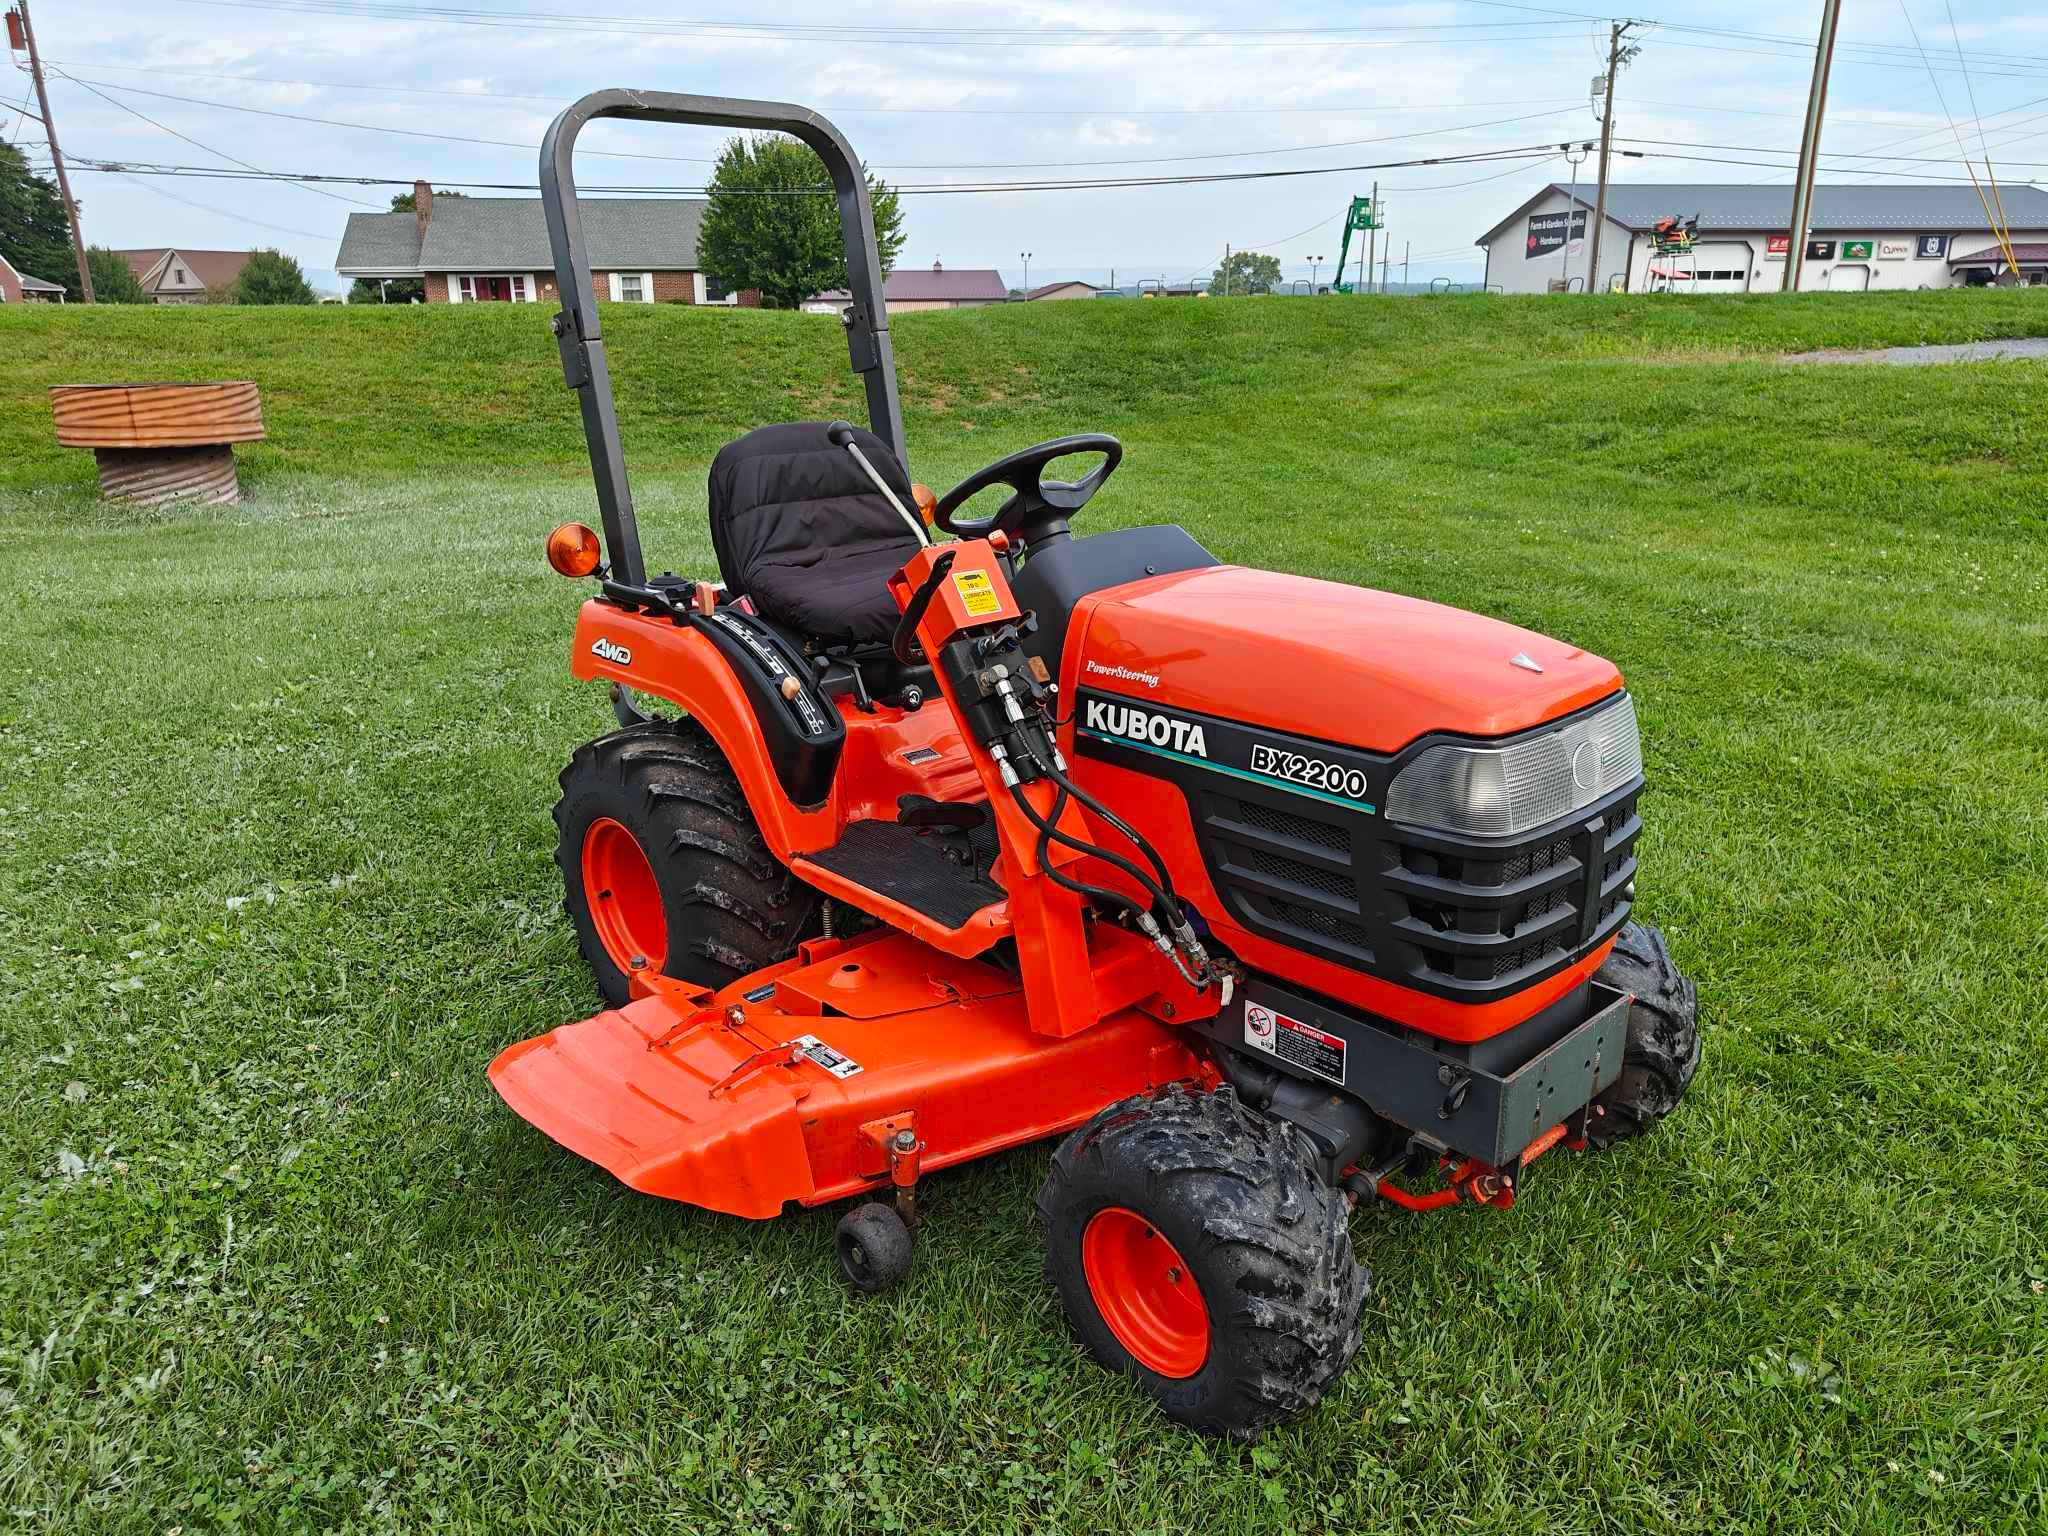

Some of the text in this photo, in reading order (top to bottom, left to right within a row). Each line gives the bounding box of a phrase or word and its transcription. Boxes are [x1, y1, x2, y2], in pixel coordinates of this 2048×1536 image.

[1530, 222, 1542, 230] Farm
[1547, 218, 1564, 229] Garden
[1564, 217, 1584, 229] Spplies
[592, 638, 631, 665] 4WD
[1086, 660, 1160, 688] PowerSteering
[1087, 700, 1208, 758] KUBOTA
[1251, 744, 1367, 798] BX2200
[1300, 1026, 1325, 1041] DANGER
